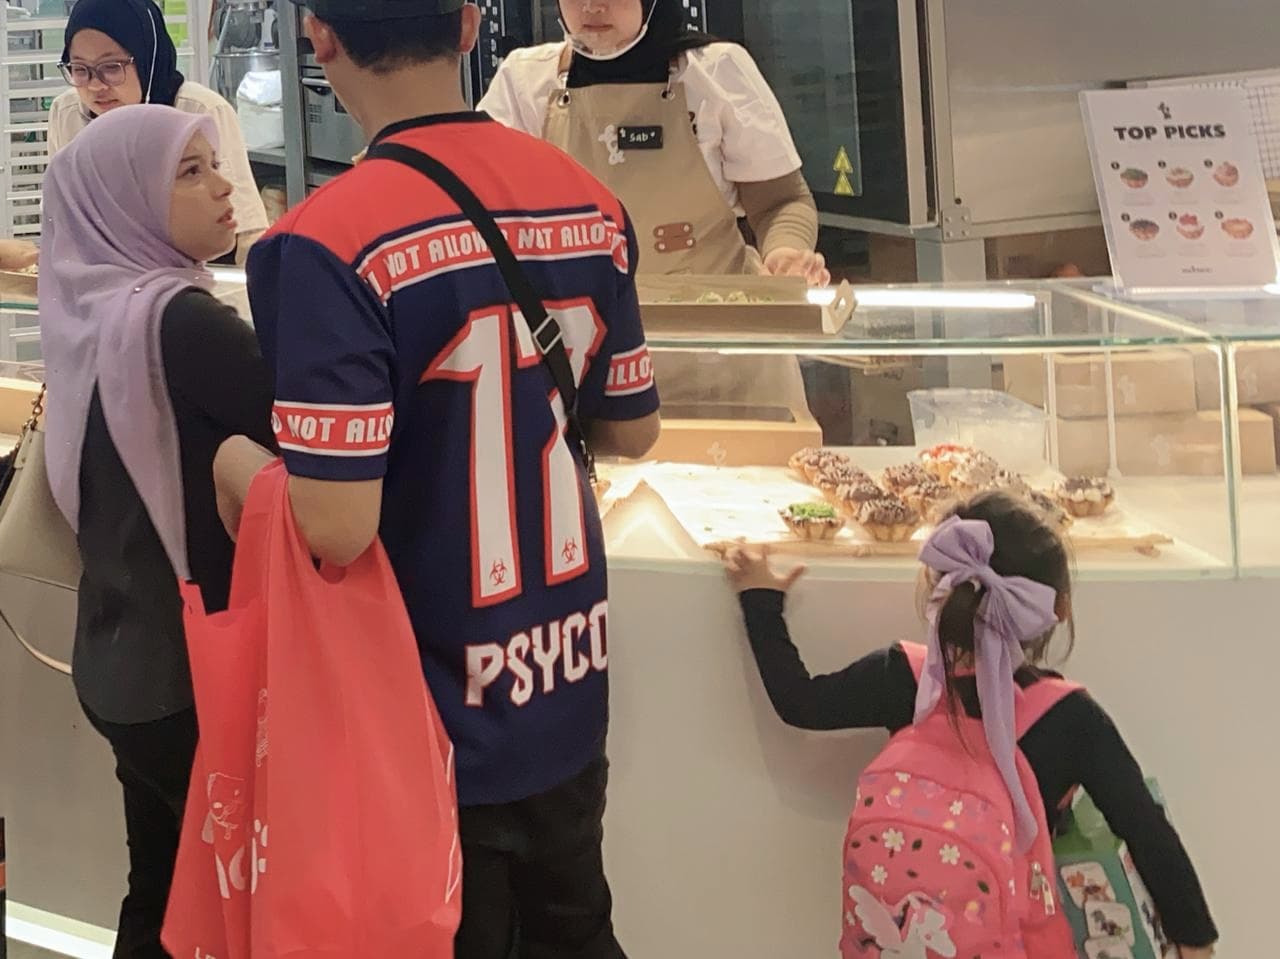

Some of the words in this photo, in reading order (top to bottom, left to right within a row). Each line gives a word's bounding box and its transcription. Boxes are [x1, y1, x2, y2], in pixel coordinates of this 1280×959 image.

[1113, 126, 1158, 141] TOP
[1164, 124, 1226, 139] PICKS
[287, 413, 336, 442] NOT
[420, 297, 608, 608] 17
